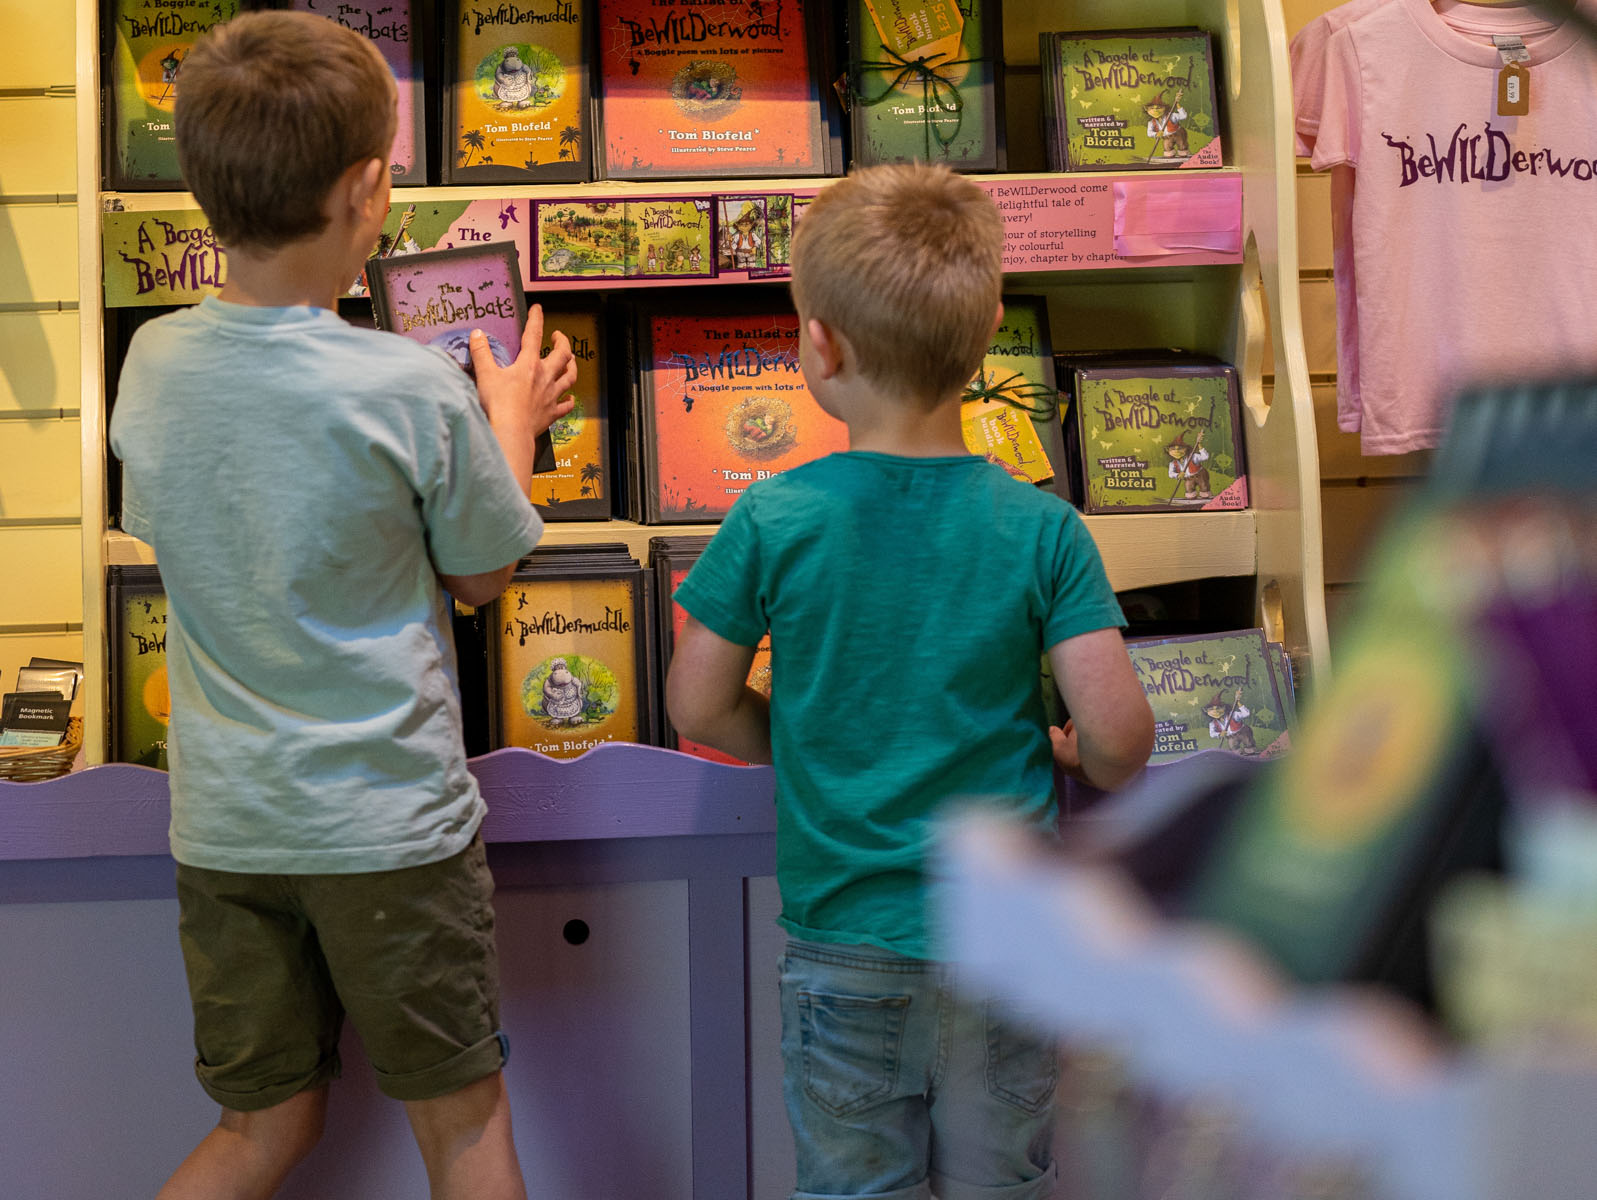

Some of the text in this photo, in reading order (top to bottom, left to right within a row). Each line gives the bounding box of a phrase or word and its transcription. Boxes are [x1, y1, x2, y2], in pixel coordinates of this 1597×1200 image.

[199, 0, 209, 8] at
[337, 5, 361, 15] The
[462, 12, 470, 25] A
[931, 3, 951, 31] £25
[123, 10, 220, 39] BeWILDerw
[909, 12, 924, 38] book
[1083, 46, 1159, 68] A Boggle at
[147, 122, 170, 131] Tom
[485, 122, 551, 133] Tom Blofeld
[668, 130, 752, 141] Tom Blofeld
[1091, 129, 1119, 137] Tom
[1086, 137, 1132, 147] Blofeld
[1381, 121, 1597, 188] BeWILDerwo
[998, 185, 1076, 196] BeWILDerwood
[1080, 184, 1108, 192] come
[996, 197, 1084, 210] delightful tale of
[138, 217, 217, 254] A Bogg
[458, 227, 492, 243] The
[1028, 230, 1038, 238] of
[1040, 229, 1096, 238] storytelling
[1020, 242, 1064, 251] colourful
[1030, 254, 1068, 264] chapter
[1072, 253, 1084, 262] by
[117, 243, 225, 295] BeWILD
[438, 283, 463, 295] The
[704, 329, 799, 340] The Ballad of
[671, 342, 800, 382] BeWILDerw
[1104, 386, 1180, 408] A Boggle at
[981, 417, 994, 447] bundle
[989, 419, 1005, 445] book
[722, 470, 752, 480] Tom
[1112, 469, 1140, 477] Tom
[1106, 478, 1153, 488] Blofeld
[505, 622, 513, 636] A
[1141, 650, 1213, 672] Boggle at
[535, 744, 559, 752] Tom
[1156, 742, 1195, 752] lofeld
